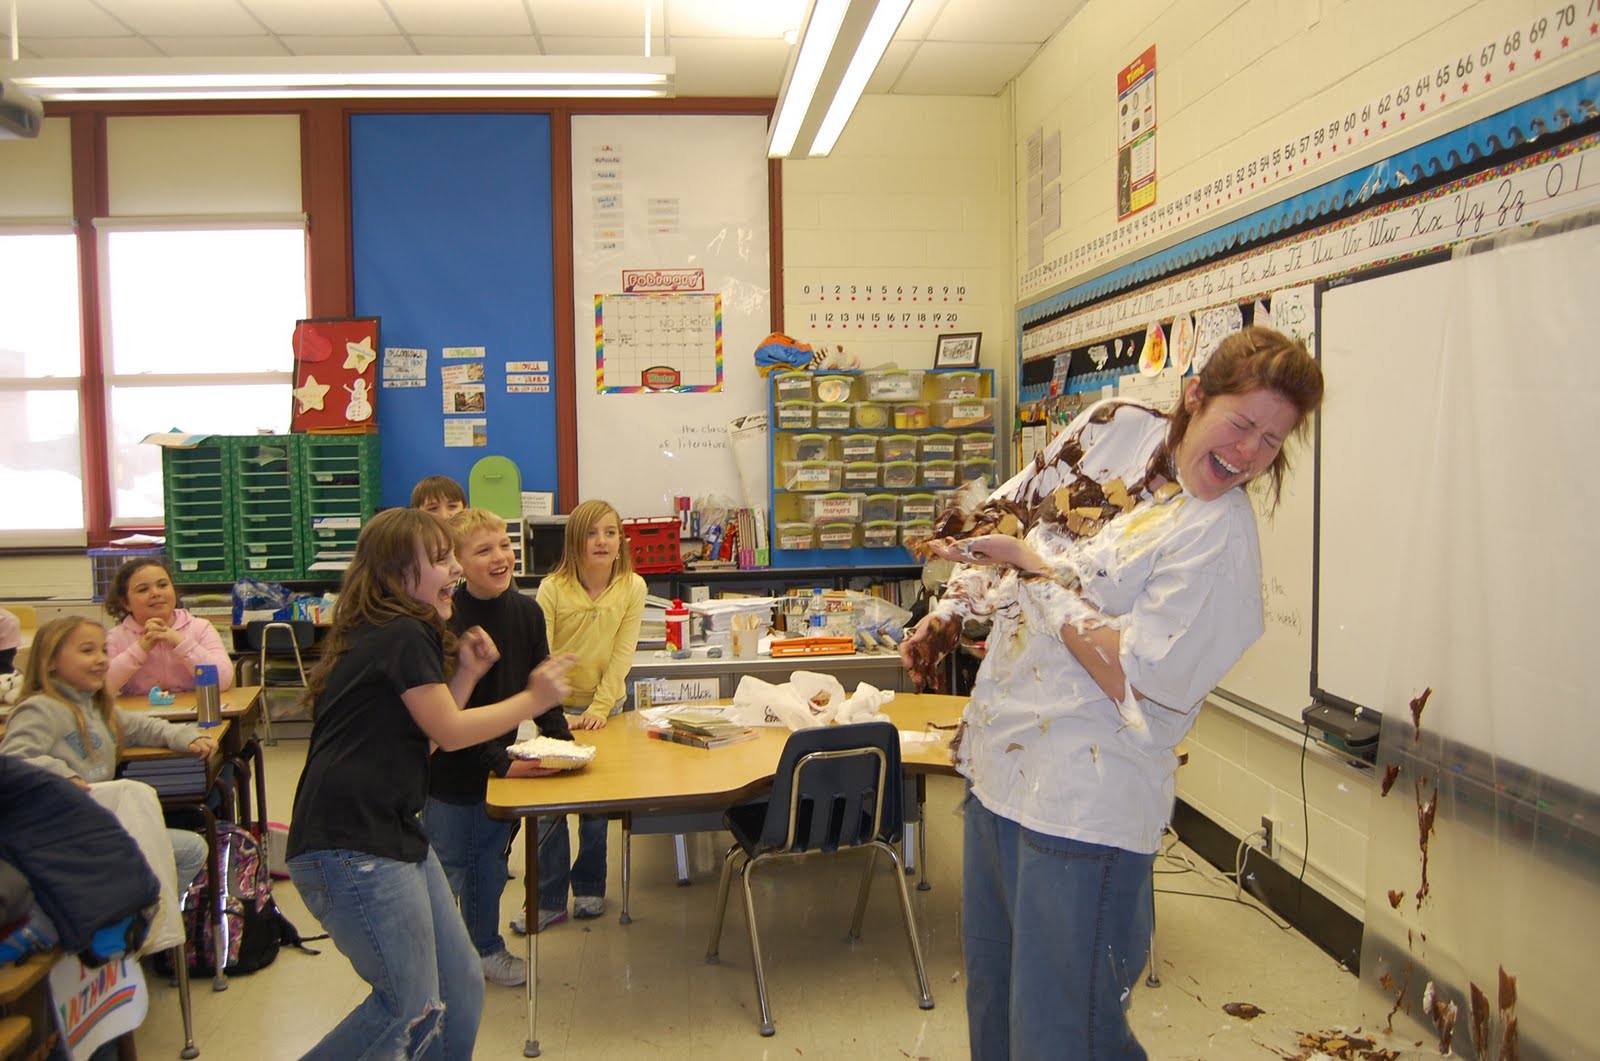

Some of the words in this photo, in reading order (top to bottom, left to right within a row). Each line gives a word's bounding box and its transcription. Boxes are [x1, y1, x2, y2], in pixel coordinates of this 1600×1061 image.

[1126, 64, 1145, 85] Time
[1185, 194, 1192, 206] 47
[1194, 189, 1201, 202] 48
[1204, 184, 1212, 198] 49
[1214, 179, 1223, 194] 50
[1226, 173, 1232, 188] 51
[1236, 168, 1244, 183] 52
[1248, 161, 1257, 177] 53
[1260, 155, 1270, 172] 54
[1272, 149, 1280, 166] 55
[1284, 143, 1296, 160] 56
[1300, 136, 1310, 153] 57
[1314, 128, 1324, 146] 58
[1328, 120, 1339, 138] 59
[1344, 112, 1356, 132] 60
[1361, 104, 1371, 124] 61
[1378, 95, 1391, 116] 62
[1396, 86, 1410, 106] 63
[1416, 76, 1430, 97] 64
[1436, 66, 1450, 87] 65
[1456, 55, 1474, 77] 66
[1480, 43, 1496, 66] 67
[1504, 32, 1520, 56] 68
[1530, 18, 1547, 43] 69
[1556, 5, 1575, 31] 70
[1241, 262, 1256, 283] Rr
[1312, 239, 1333, 264] Uu
[1342, 228, 1362, 256] Vv
[1368, 217, 1401, 248] Ww
[1410, 207, 1443, 237] Xx
[1454, 194, 1485, 236] Yy
[1497, 179, 1526, 226] Zz
[1575, 155, 1584, 190] 1
[628, 273, 697, 287] February
[804, 286, 810, 294] 0
[835, 286, 840, 294] 2
[850, 286, 856, 294] 3
[866, 286, 872, 294] 4
[882, 286, 888, 294] 5
[896, 286, 902, 294] 6
[912, 286, 918, 294] 7
[928, 286, 933, 294] 8
[942, 286, 948, 295] 9
[956, 286, 966, 295] 10
[811, 313, 816, 322] 11
[825, 313, 833, 322] 12
[840, 313, 849, 322] 13
[856, 313, 864, 322] 14
[872, 313, 880, 322] 15
[887, 313, 895, 322] 16
[902, 313, 910, 322] 17
[918, 313, 926, 322] 18
[933, 313, 941, 322] 19
[947, 313, 957, 322] 20
[648, 374, 675, 382] Winter
[682, 425, 695, 433] the
[659, 440, 669, 449] of
